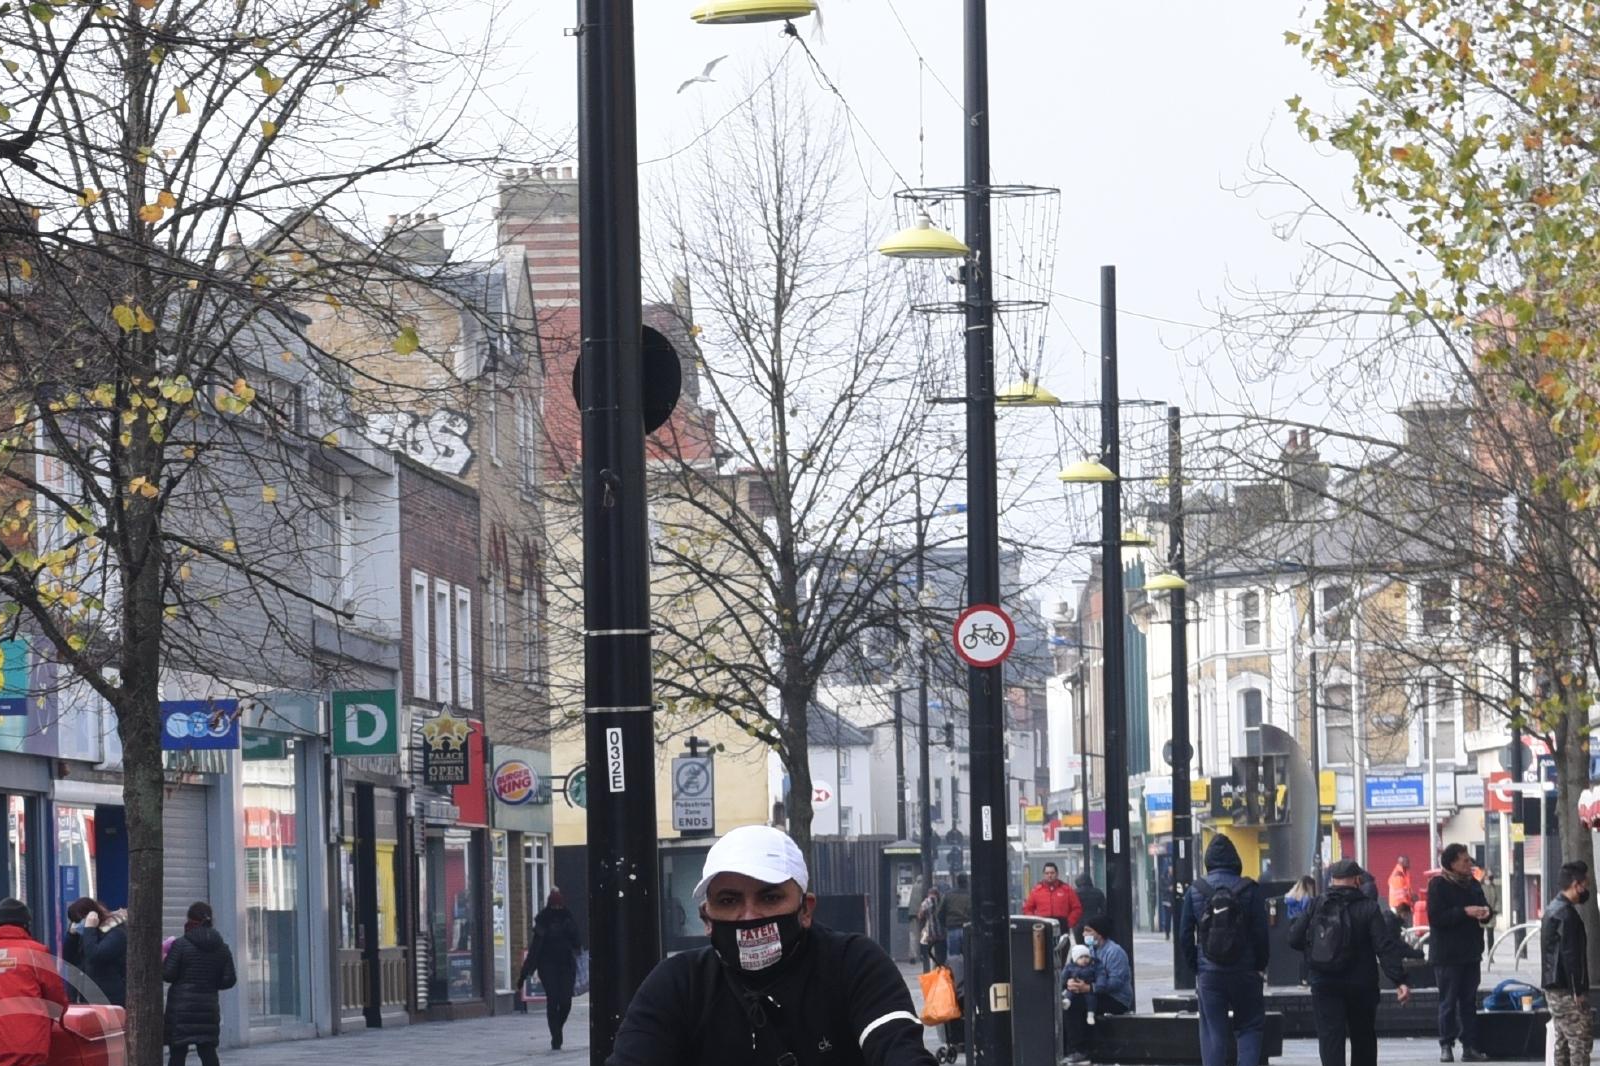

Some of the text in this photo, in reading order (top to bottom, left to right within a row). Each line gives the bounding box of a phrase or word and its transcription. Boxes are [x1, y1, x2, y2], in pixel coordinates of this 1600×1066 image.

[428, 752, 464, 760] PALACE
[609, 730, 624, 790] 032E
[428, 765, 464, 776] OPEN
[496, 768, 530, 786] BURGER
[498, 777, 532, 797] KING
[678, 817, 708, 827] ENDS
[741, 923, 776, 941] FATEH
